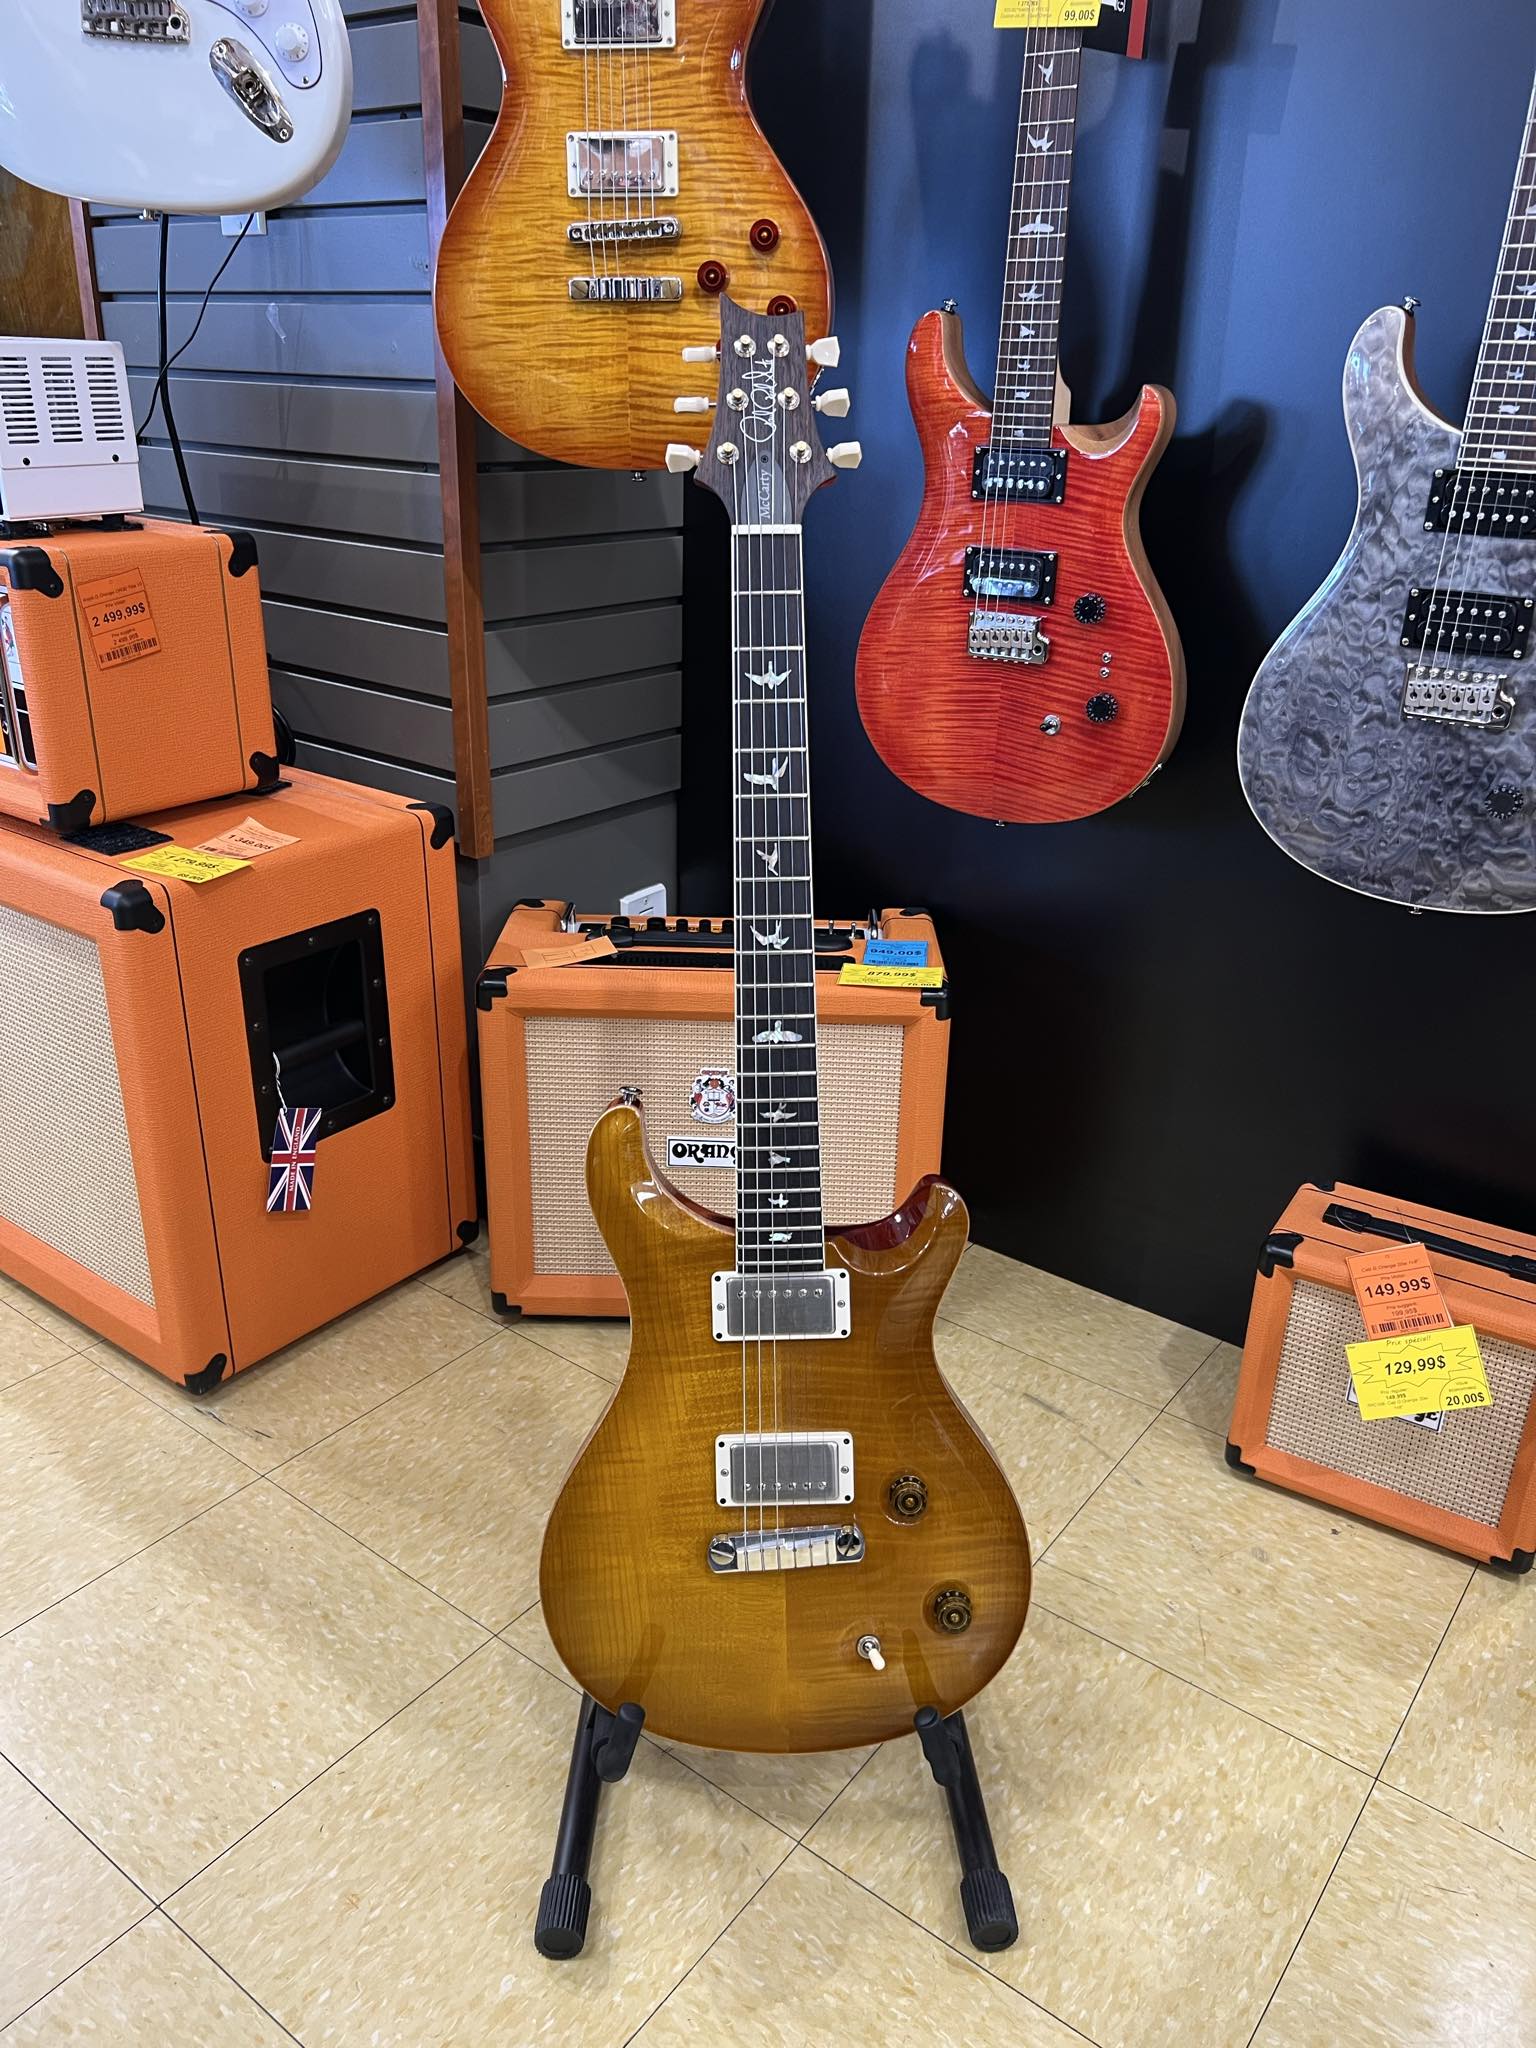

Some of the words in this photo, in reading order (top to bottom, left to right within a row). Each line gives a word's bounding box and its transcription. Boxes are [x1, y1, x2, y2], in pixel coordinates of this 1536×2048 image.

[1064, 9, 1096, 21] 99,00$
[759, 469, 772, 519] McCarty
[103, 602, 146, 624] 499,99$
[291, 1126, 301, 1159] ENGLAND
[290, 1161, 297, 1170] IN
[1364, 1276, 1431, 1298] 149,99$
[1386, 1339, 1401, 1347] Prix
[1384, 1355, 1446, 1376] 129,99$
[1445, 1392, 1485, 1406] 20,00$
